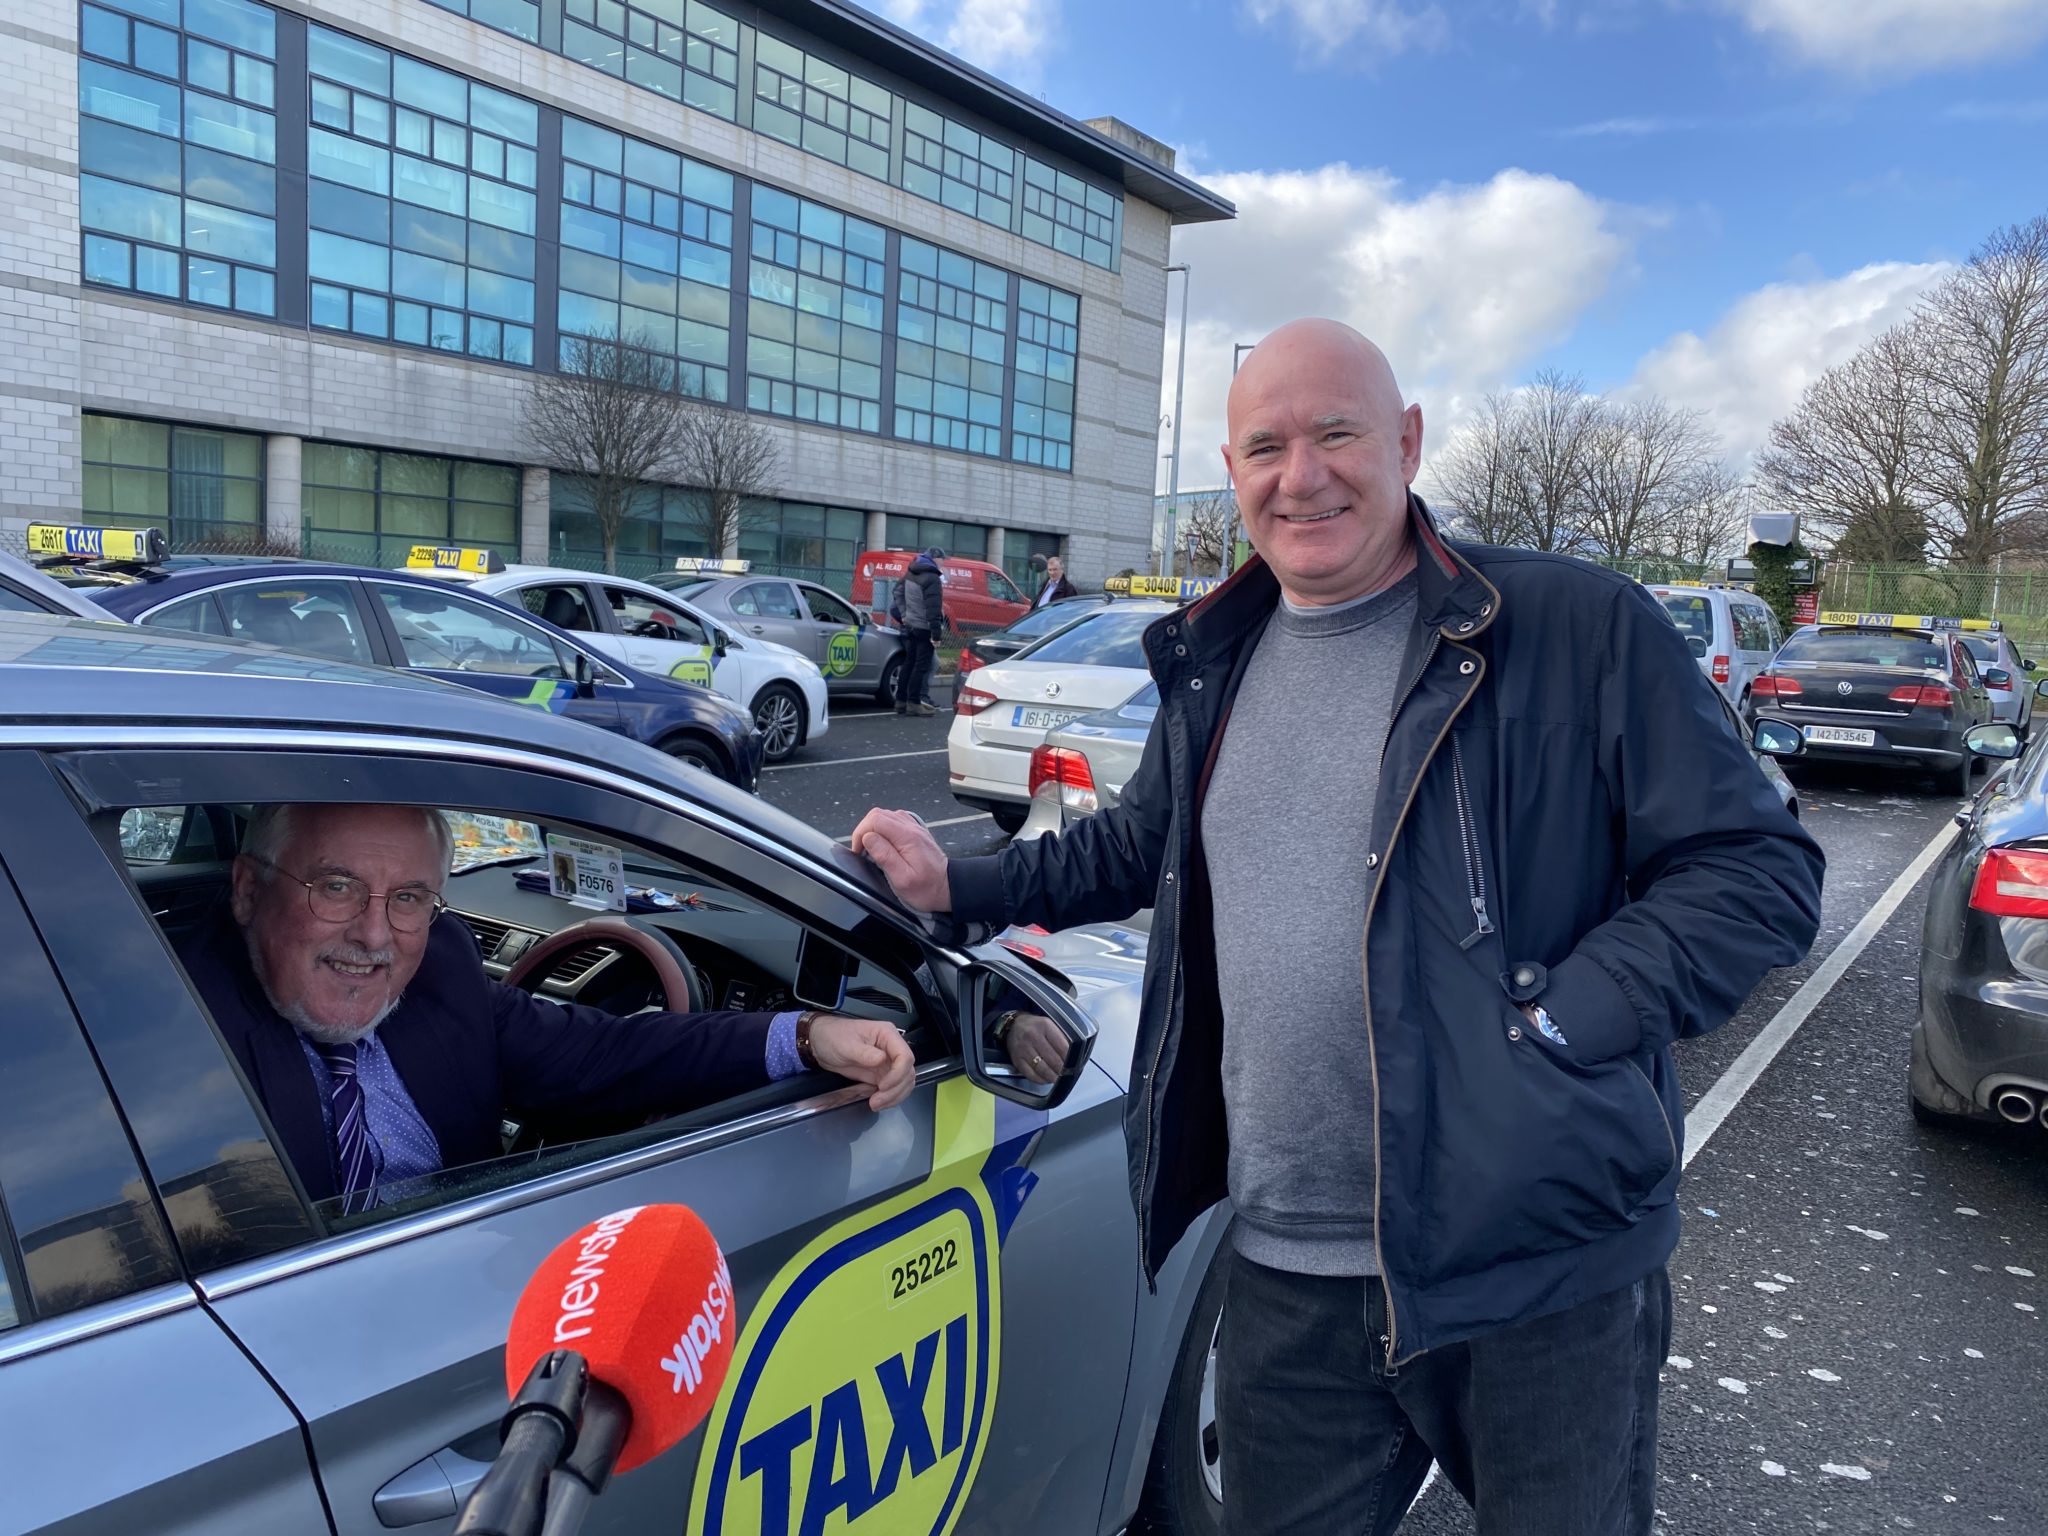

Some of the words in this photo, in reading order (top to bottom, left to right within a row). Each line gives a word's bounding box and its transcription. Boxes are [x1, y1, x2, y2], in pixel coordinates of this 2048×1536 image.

[40, 529, 63, 550] 26617
[69, 530, 99, 553] TAXI
[134, 534, 144, 555] D
[437, 550, 459, 566] TAXI
[477, 554, 486, 566] D
[703, 560, 722, 569] TAXI
[1144, 578, 1177, 593] 30408
[1828, 613, 1857, 623] 18019
[1861, 615, 1892, 626] TAXI
[1921, 618, 1931, 627] D
[832, 646, 854, 661] TAXI
[1816, 729, 1867, 742] 142-D-3545
[578, 873, 614, 894] F0576
[891, 1238, 958, 1299] 25222
[740, 1312, 968, 1536] TAXI
